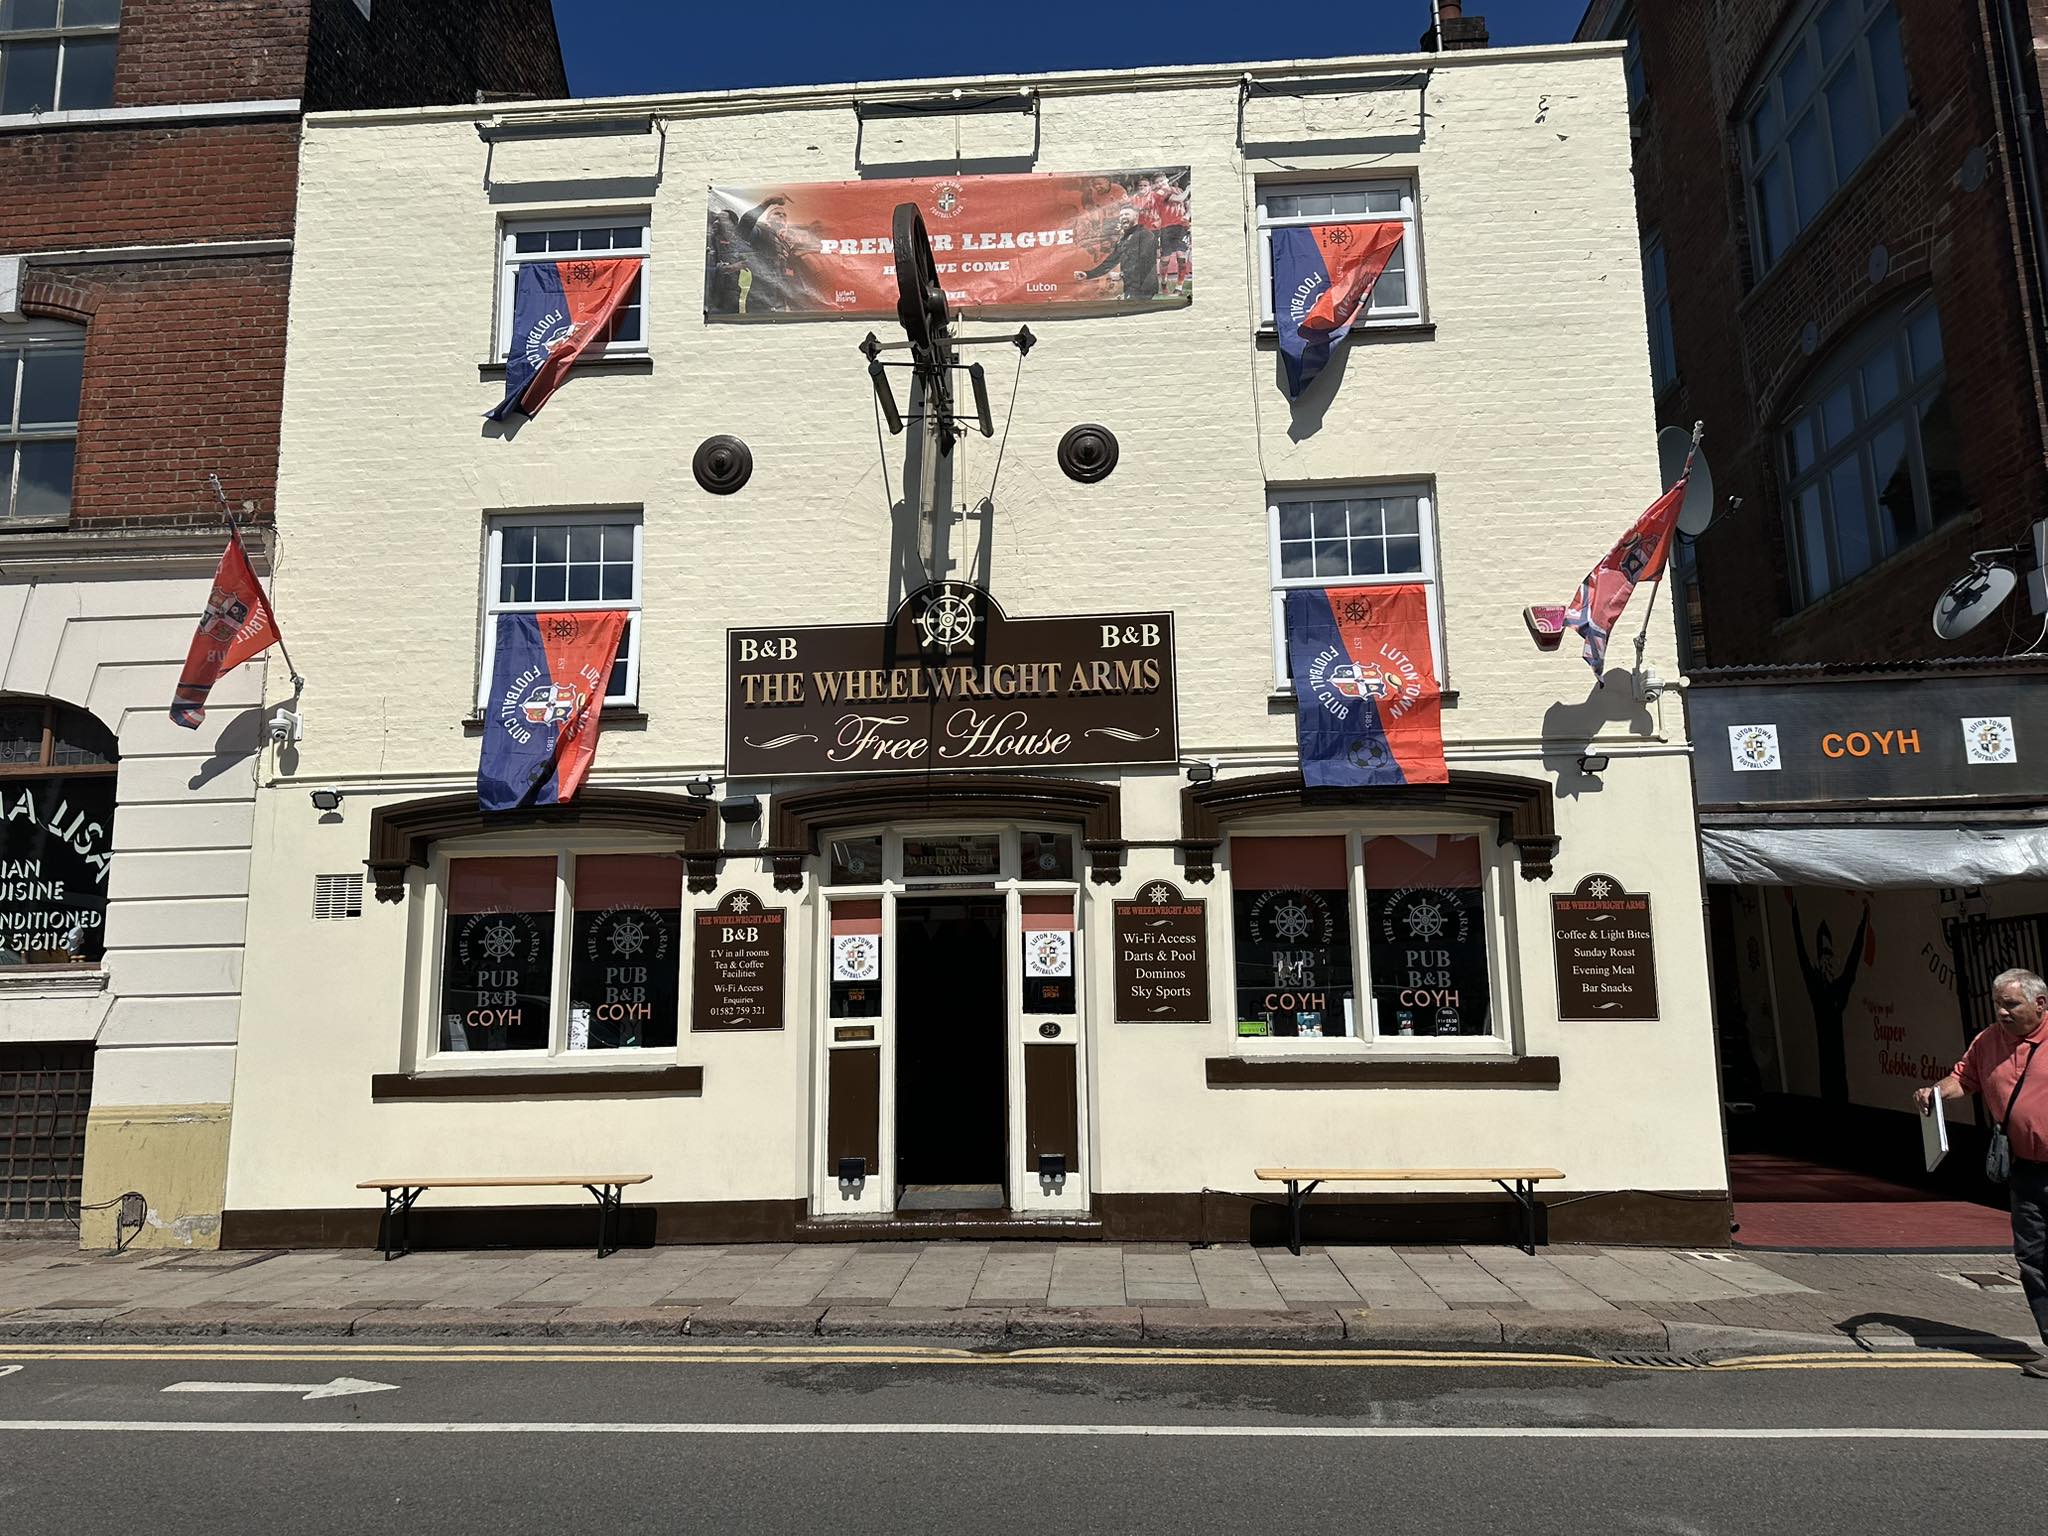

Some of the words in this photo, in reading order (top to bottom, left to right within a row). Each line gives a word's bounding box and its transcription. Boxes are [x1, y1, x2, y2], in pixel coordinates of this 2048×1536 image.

[820, 235, 954, 255] PREMR
[962, 229, 1074, 250] LEAGUE
[935, 263, 957, 273] WE
[961, 261, 1010, 273] COME
[1026, 283, 1057, 292] Luton
[1290, 271, 1322, 321] FOOTBALL
[525, 309, 563, 355] FOOTBALL
[1100, 623, 1160, 649] B&B
[738, 636, 798, 662] B&B
[1309, 645, 1340, 691] FOOTBALL
[1379, 642, 1419, 681] LUTON
[740, 673, 804, 705] THE
[813, 662, 1062, 702] WHEELWRIGHT
[1068, 658, 1160, 695] ARMS
[502, 665, 542, 718] FOOTBALL
[1318, 690, 1350, 721] CLUB
[1389, 683, 1420, 720] TOWN
[504, 717, 532, 745] CLUB
[1734, 727, 1752, 741] LUTON
[1754, 727, 1773, 740] TOWN
[1967, 720, 1987, 733] LUTON
[1989, 719, 2007, 732] TOWN
[827, 713, 928, 763] Free
[938, 708, 1072, 760] House
[1821, 729, 1921, 758] COYH
[935, 864, 969, 874] ARMS
[1250, 886, 1327, 919] WHEELWRIGHT
[1383, 884, 1462, 916] WHEELWRIGHT
[461, 904, 537, 938] WHEELWRIGHT
[589, 902, 665, 936] WHEELWRIGHT
[1320, 911, 1335, 945] ARMS
[1456, 909, 1469, 944] ARMS
[721, 927, 759, 943] B&B
[1030, 932, 1048, 946] LUTON
[1049, 933, 1065, 946] TOWN
[1123, 933, 1155, 944] Wi-Fi
[1158, 933, 1197, 944] Access
[1248, 920, 1262, 944] THE
[1382, 918, 1396, 944] THE
[1556, 930, 1587, 940] Coffee
[1589, 930, 1598, 939] &
[1600, 929, 1625, 941] Light
[1627, 929, 1651, 939] Bites
[527, 930, 541, 964] ARMS
[588, 937, 599, 962] THE
[656, 928, 669, 961] ARMS
[838, 937, 856, 950] LUTON
[857, 936, 874, 950] TOWN
[459, 940, 470, 965] THE
[734, 949, 744, 957] all
[1124, 951, 1154, 962] Darts
[1157, 951, 1167, 961] &
[1171, 950, 1196, 961] Pool
[1271, 950, 1316, 968] PUB
[1406, 950, 1451, 968] PUB
[1574, 948, 1607, 959] Sunday
[1609, 947, 1636, 957] Roast
[714, 961, 728, 969] Tea
[729, 961, 737, 969] &
[738, 960, 764, 969] Coffee
[722, 969, 757, 978] Facilities
[838, 964, 862, 979] FOOTBALL
[862, 964, 874, 976] CLUB
[1030, 961, 1054, 975] FOOTBALL
[1054, 961, 1067, 973] CLUB
[1136, 968, 1186, 979] Dominos
[1572, 965, 1611, 977] Evening
[1612, 965, 1635, 975] Meal
[476, 969, 519, 988] PUB
[605, 967, 648, 984] PUB
[1274, 970, 1316, 988] B&B
[1408, 970, 1451, 988] B&B
[605, 986, 646, 1004] B&B
[714, 984, 736, 993] Wi-Fi
[737, 983, 764, 992] Access
[1131, 985, 1153, 999] Sky
[1156, 985, 1191, 999] Sports
[1582, 983, 1599, 993] Bar
[1600, 983, 1633, 993] Snacks
[476, 990, 518, 1008] B&B
[1265, 993, 1325, 1010] COYH
[1400, 990, 1459, 1008] COYH
[466, 1009, 522, 1027] COYH
[596, 1003, 651, 1021] COYH
[710, 1007, 734, 1016] 01582
[736, 1006, 750, 1015] 759
[752, 1006, 765, 1015] 321
[1044, 1025, 1056, 1034] 34
[1873, 1016, 1907, 1050] Super
[1879, 1049, 1917, 1080] Robbie
